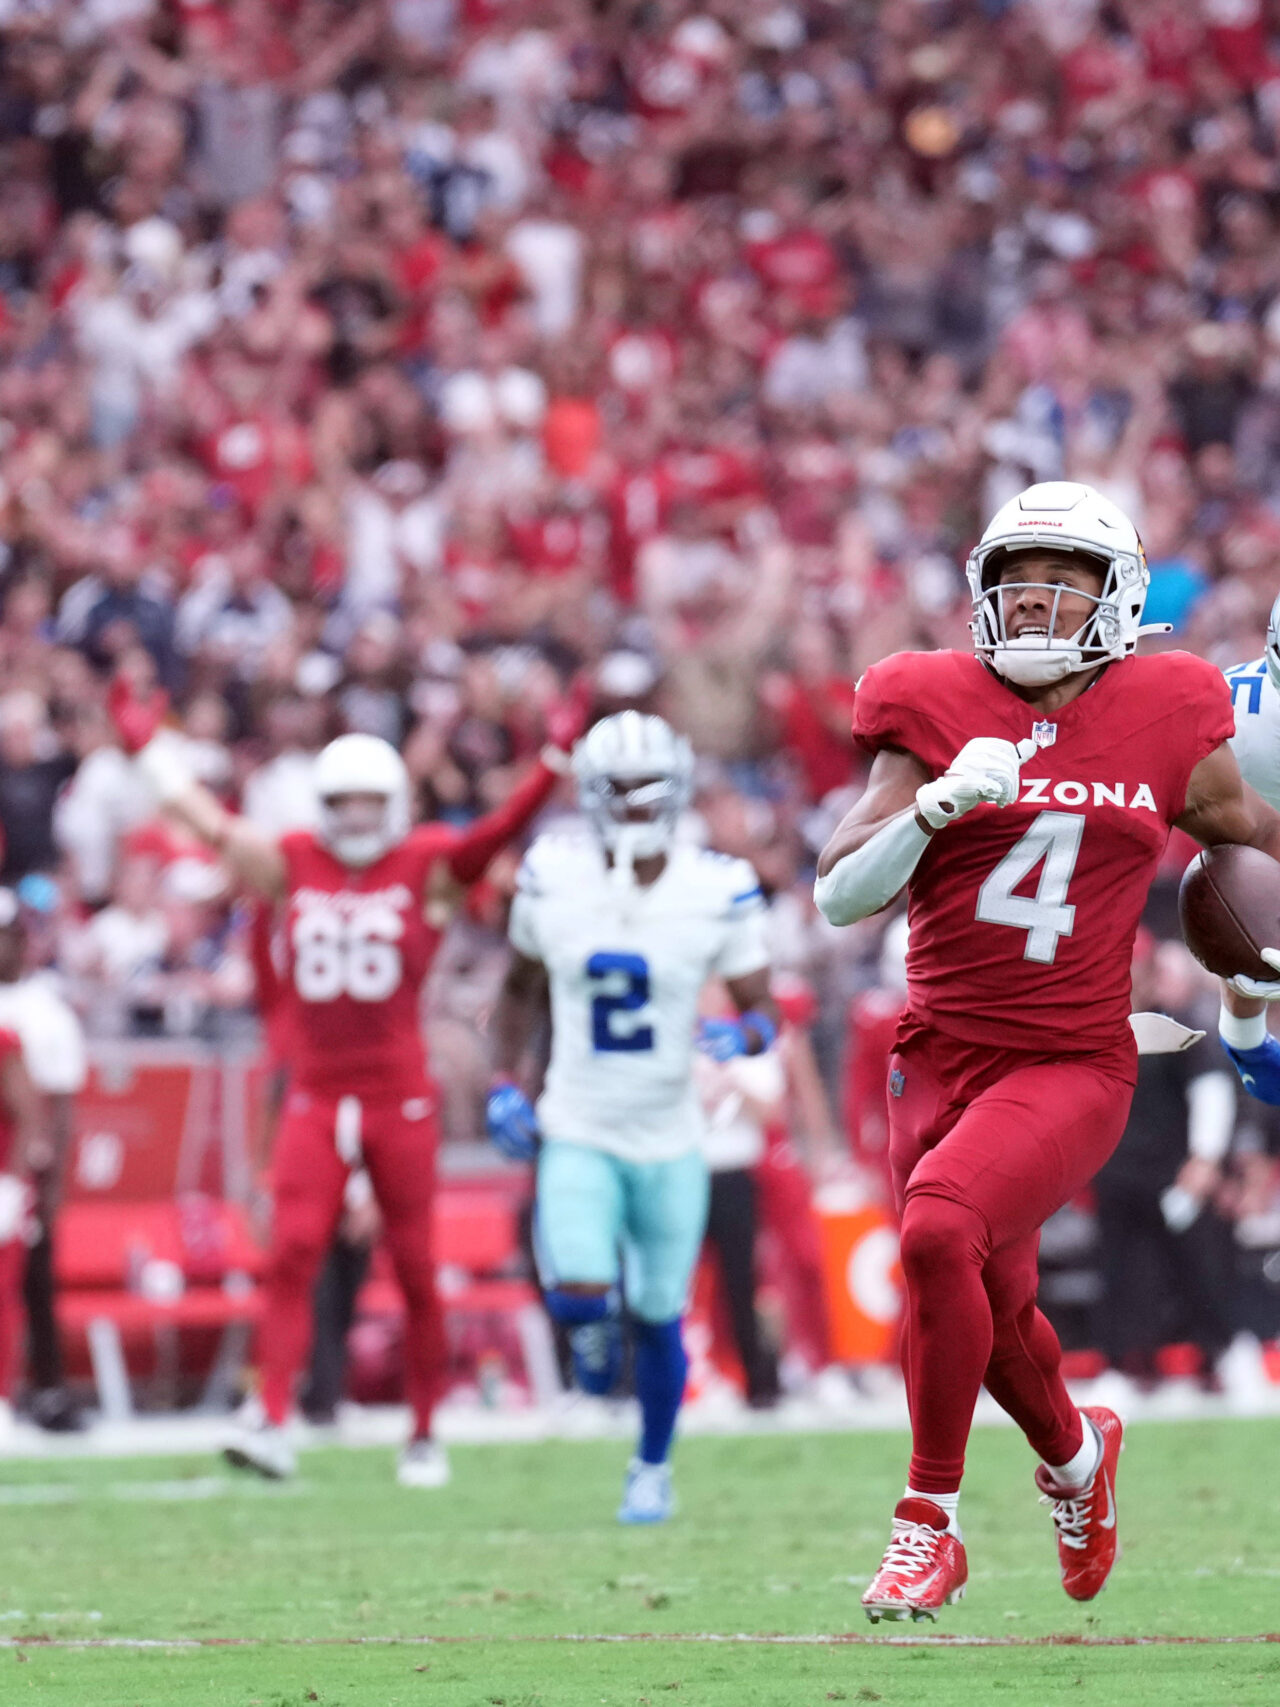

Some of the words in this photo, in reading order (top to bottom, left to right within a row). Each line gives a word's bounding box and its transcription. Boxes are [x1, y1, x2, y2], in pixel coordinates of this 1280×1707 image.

[1018, 777, 1158, 813] ZONA
[974, 809, 1086, 966] 4
[292, 909, 405, 1003] 86
[587, 951, 654, 1052] 2
